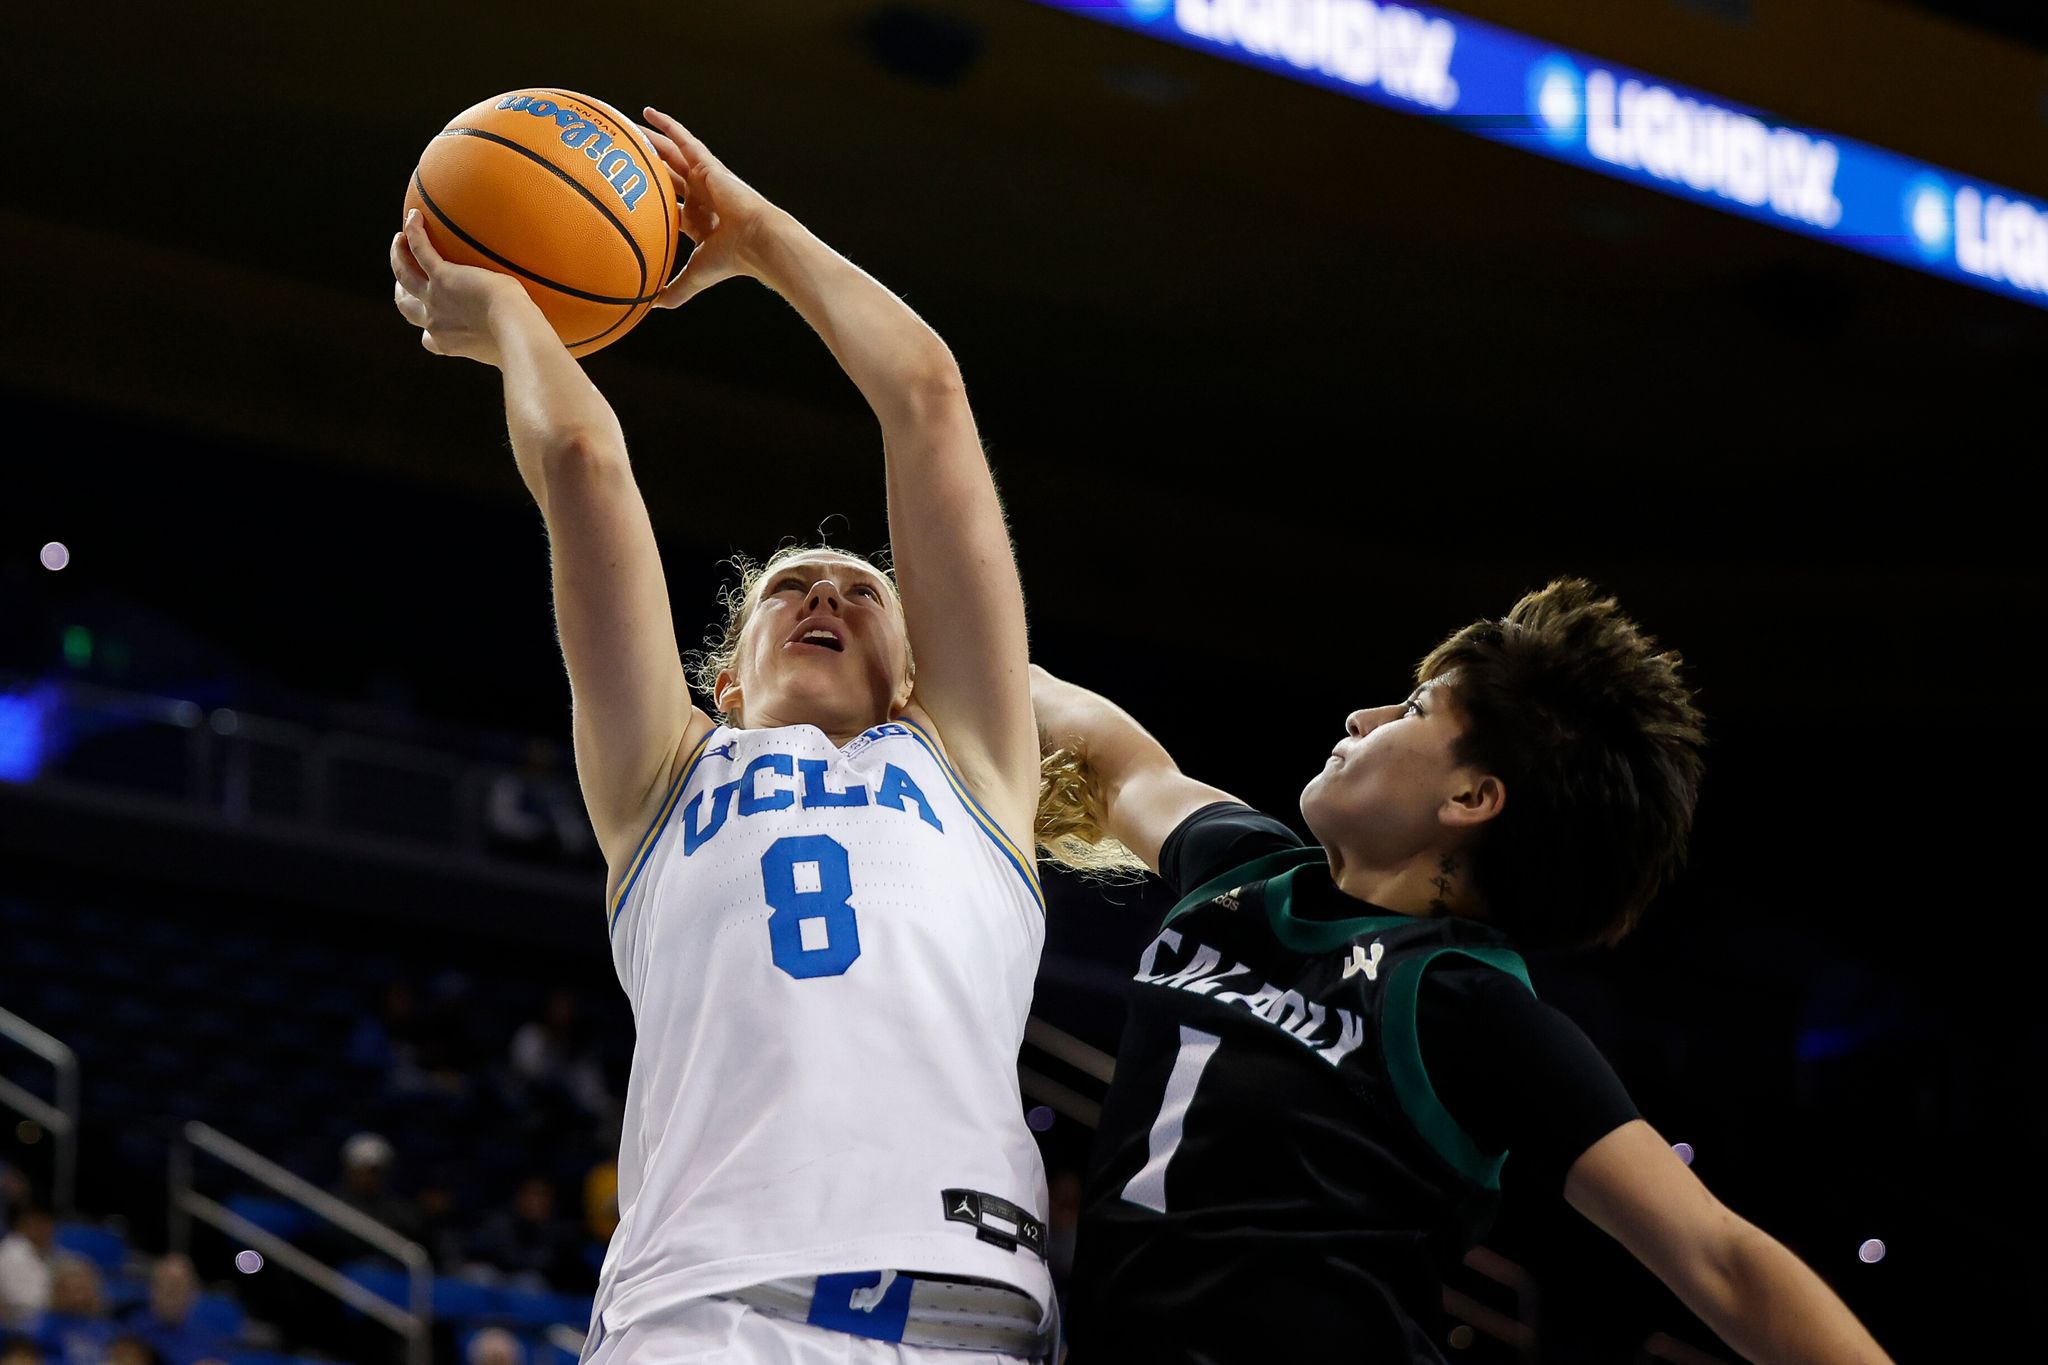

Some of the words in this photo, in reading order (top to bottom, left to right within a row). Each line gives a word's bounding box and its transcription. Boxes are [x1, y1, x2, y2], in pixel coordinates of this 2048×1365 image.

[494, 95, 649, 213] Wilson
[593, 117, 617, 137] EVO
[1953, 185, 2048, 296] LIQ
[681, 753, 945, 857] UCLA
[760, 834, 861, 980] 8
[1133, 927, 1251, 995] CAL
[1214, 982, 1364, 1068] POLY
[1120, 1025, 1222, 1214] 1
[1023, 1222, 1040, 1241] 42
